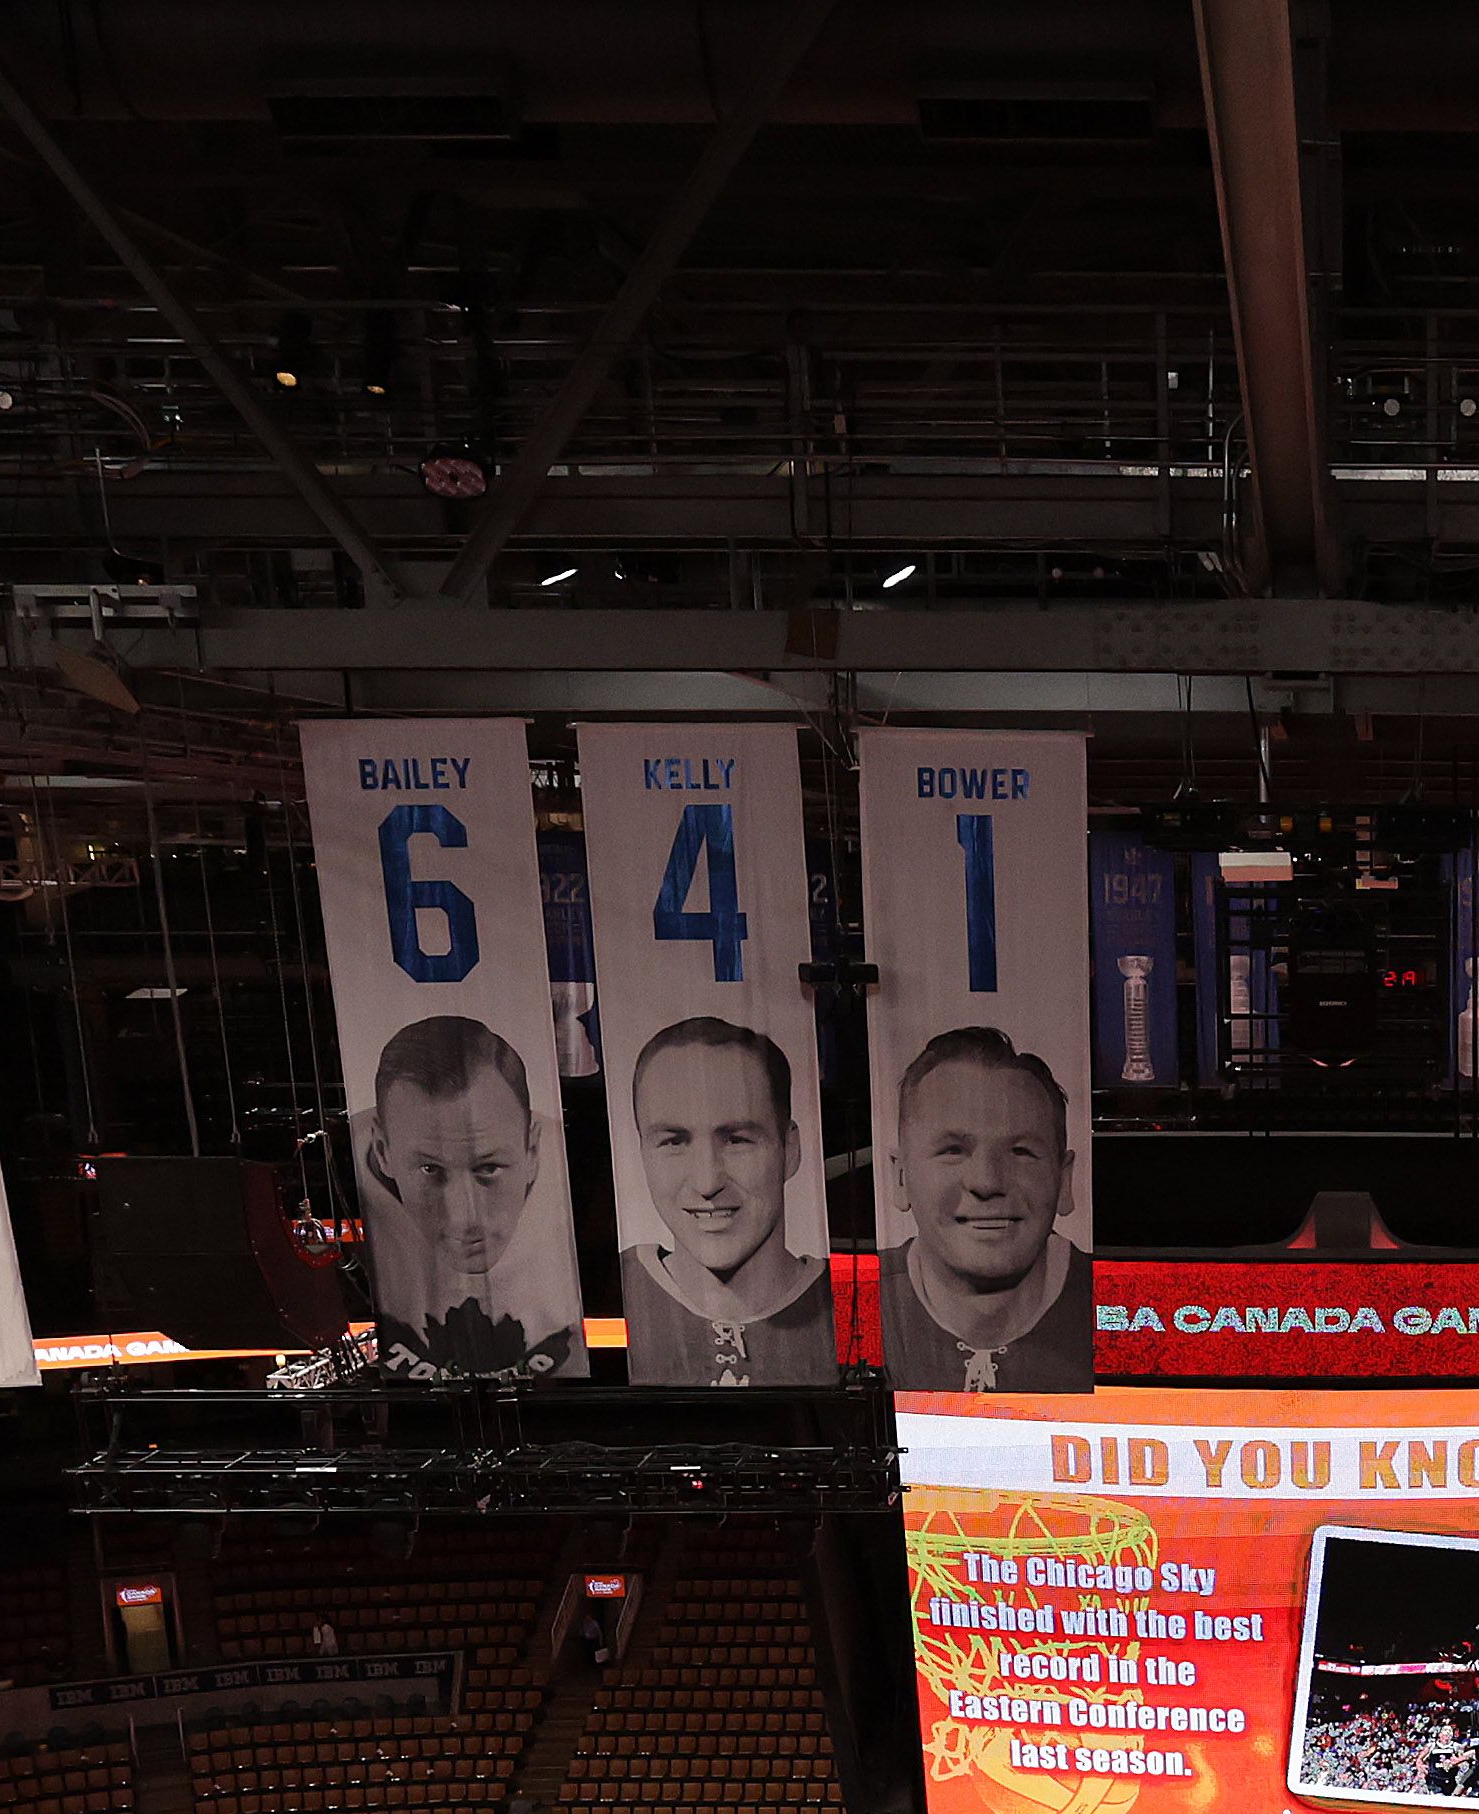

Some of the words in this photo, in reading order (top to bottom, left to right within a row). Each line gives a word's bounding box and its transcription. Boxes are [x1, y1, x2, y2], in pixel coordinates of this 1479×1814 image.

[358, 758, 471, 790] BAILEY
[643, 757, 735, 790] KELLY
[917, 767, 1029, 800] BOWER
[378, 805, 480, 983] 6
[652, 804, 748, 983] 4
[956, 814, 997, 992] 1
[1103, 872, 1163, 904] 1947
[1174, 1303, 1381, 1334] CANADA
[35, 1343, 120, 1362] ANADA
[1051, 1434, 1171, 1488] DID
[1192, 1436, 1332, 1489] YOU
[965, 1551, 1018, 1588] The
[1026, 1556, 1152, 1595] Chicago
[1159, 1561, 1215, 1597] Sky
[930, 1597, 1054, 1638] finished
[1062, 1606, 1130, 1638] with
[1136, 1604, 1185, 1640] the
[1193, 1609, 1264, 1643] best
[998, 1650, 1102, 1685] record
[1110, 1652, 1138, 1684] in
[1144, 1654, 1196, 1686] the
[949, 1691, 1062, 1726] Eastern
[1068, 1696, 1245, 1734] Conference
[1010, 1735, 1070, 1771] last
[1076, 1744, 1193, 1777] season.
